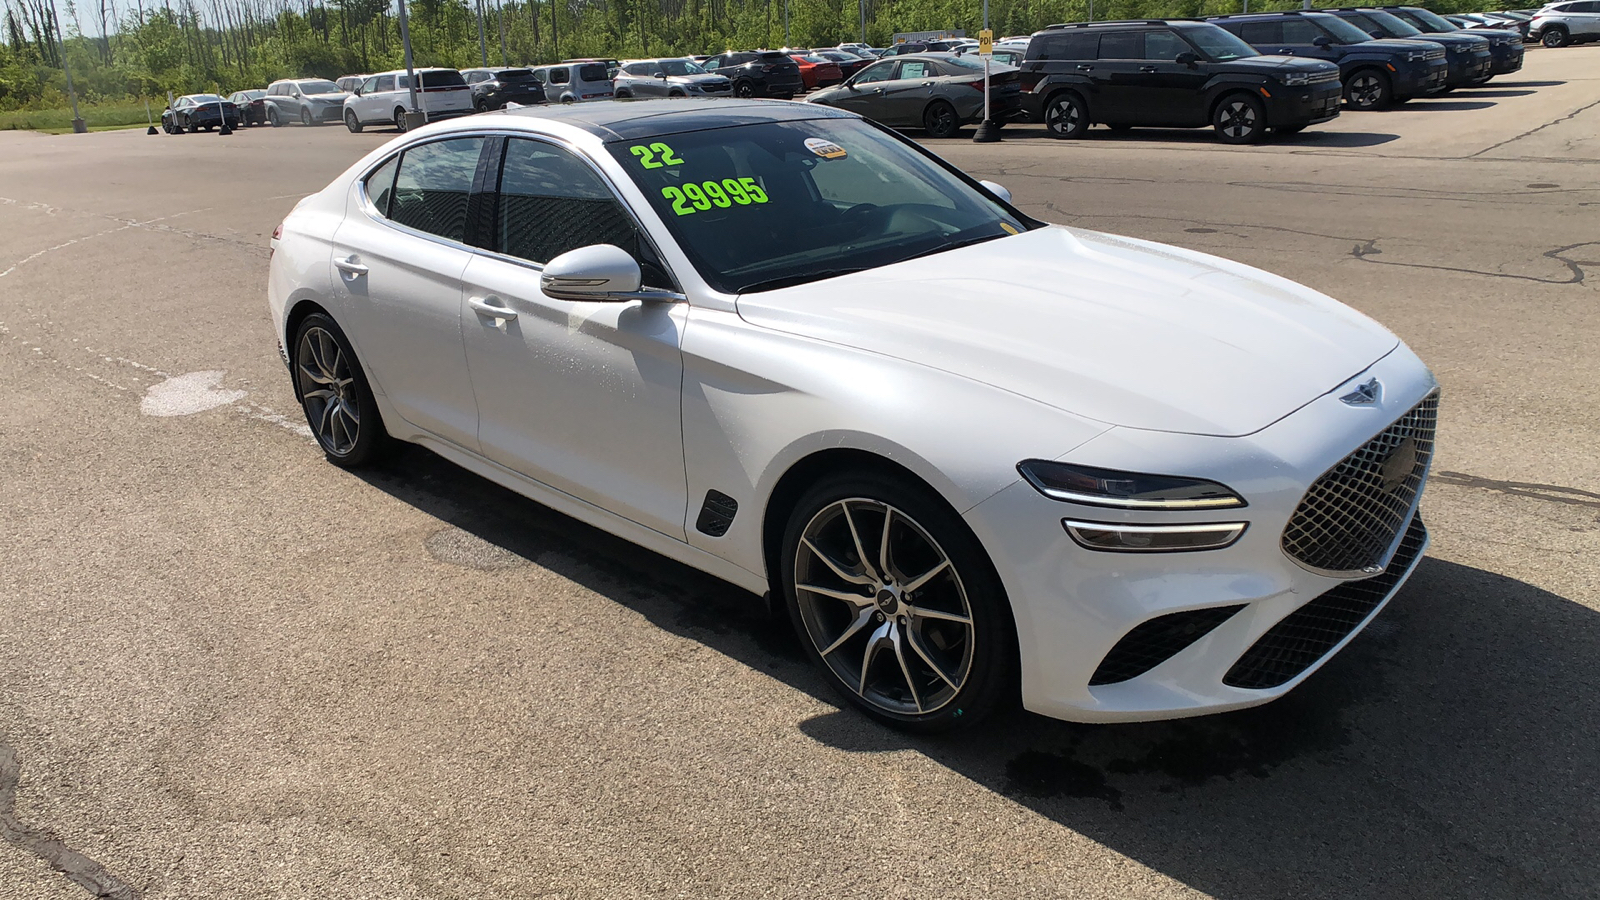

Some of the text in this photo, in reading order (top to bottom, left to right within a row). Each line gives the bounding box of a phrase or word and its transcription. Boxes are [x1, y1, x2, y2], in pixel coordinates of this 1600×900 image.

[980, 36, 991, 45] PDI
[629, 142, 684, 170] 22
[661, 177, 768, 215] 29995
